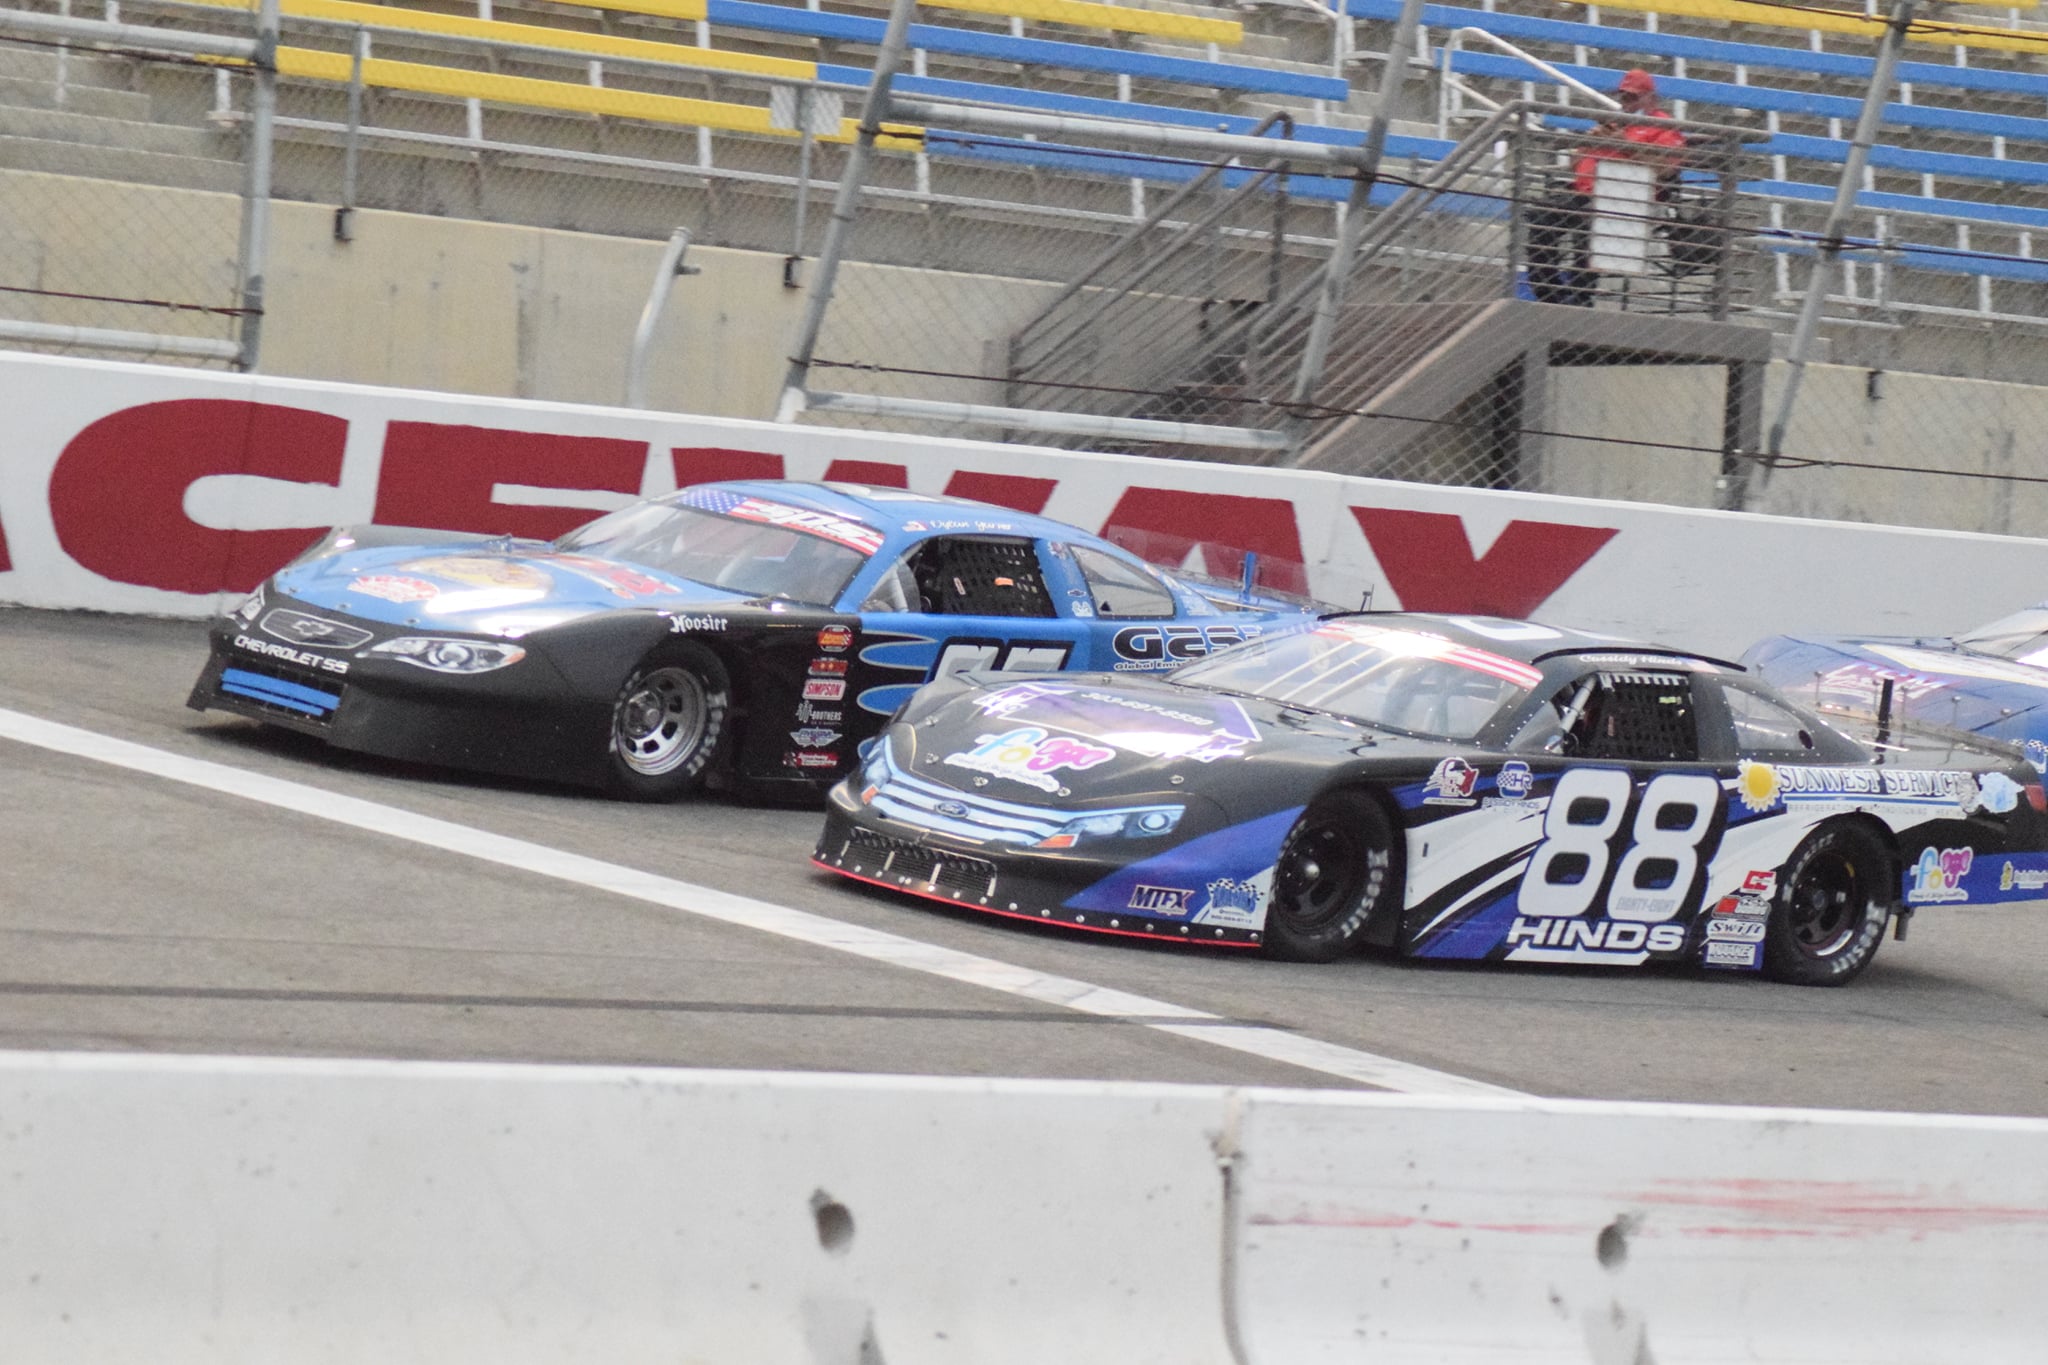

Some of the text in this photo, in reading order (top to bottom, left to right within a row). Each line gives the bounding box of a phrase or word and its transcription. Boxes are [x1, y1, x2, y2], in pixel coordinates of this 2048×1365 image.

[670, 614, 728, 633] Hoosier
[234, 634, 351, 675] CHEVROLET SS
[1579, 654, 1683, 665] Cassidy Hinds
[1114, 660, 1154, 671] Global
[806, 682, 842, 697] SIMPSON
[1777, 766, 1881, 794] SUNWEST
[1517, 767, 1723, 924] 88
[1507, 917, 1687, 952] HINDS
[1710, 922, 1763, 936] Swift
